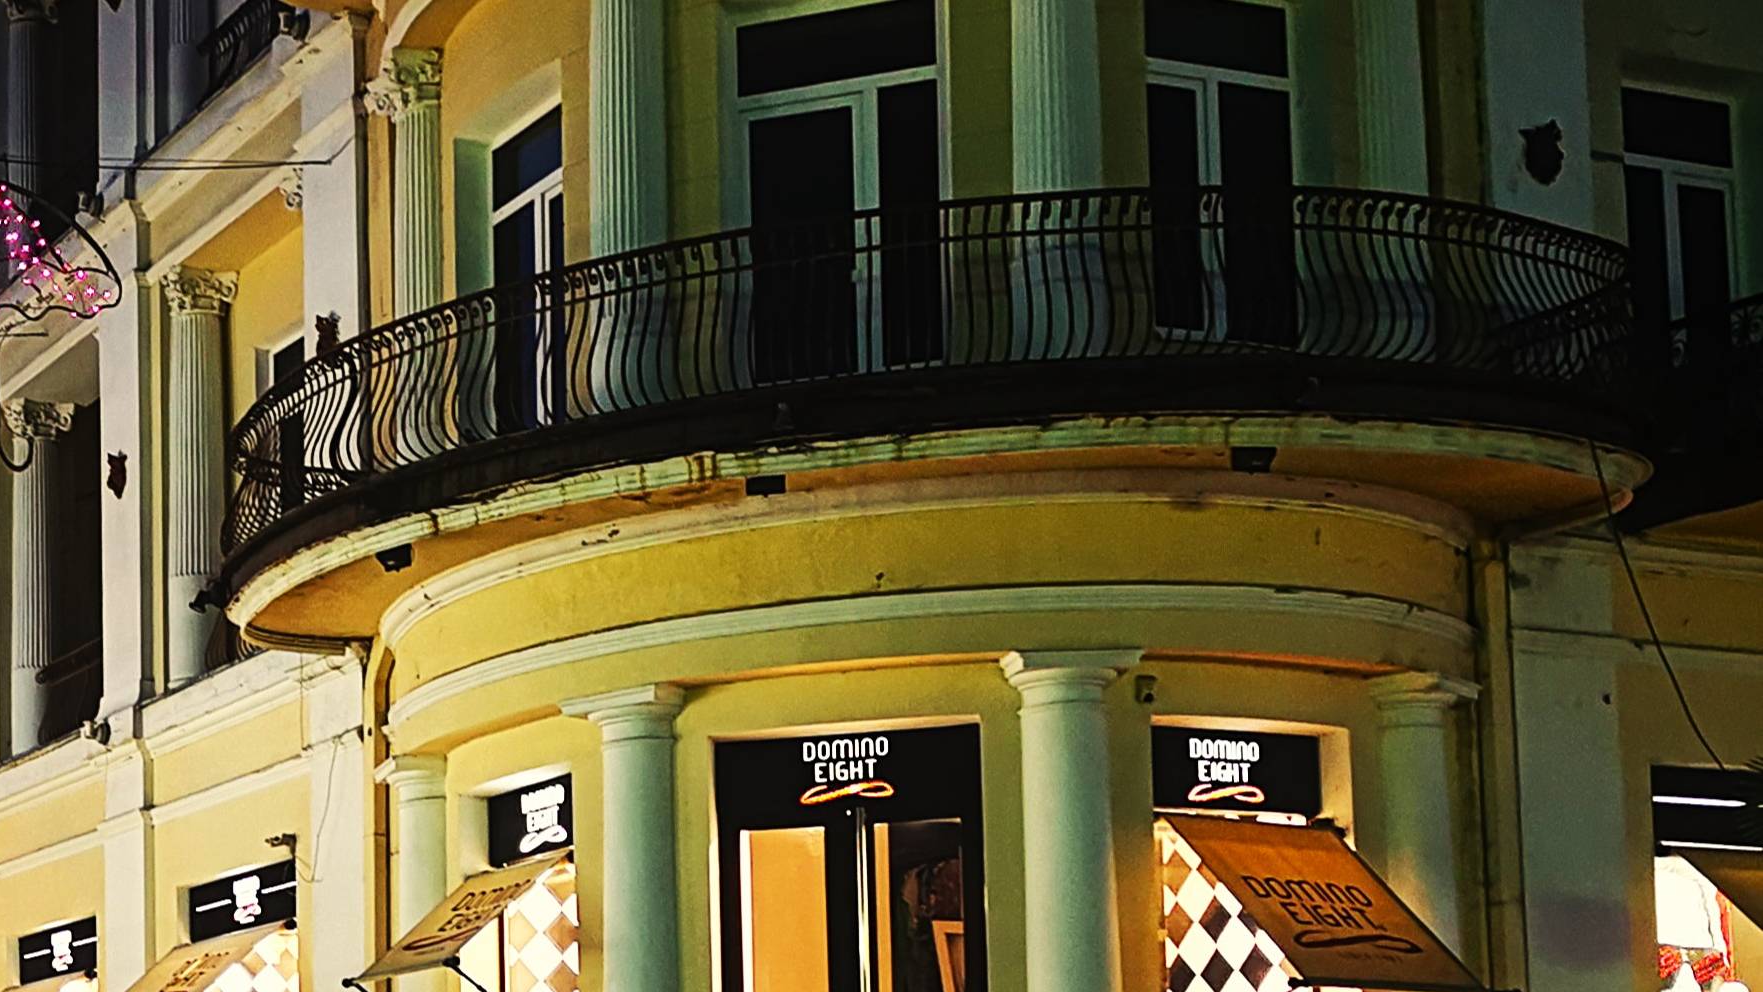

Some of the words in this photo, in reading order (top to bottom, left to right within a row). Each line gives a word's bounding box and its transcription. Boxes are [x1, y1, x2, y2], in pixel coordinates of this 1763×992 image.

[802, 736, 889, 762] DOMINO
[1188, 737, 1260, 762] DOMINO
[814, 758, 878, 783] EIGHT
[1197, 760, 1251, 783] EIGHT
[1241, 874, 1373, 908] DOMINO
[1279, 901, 1384, 932] EIGHT
